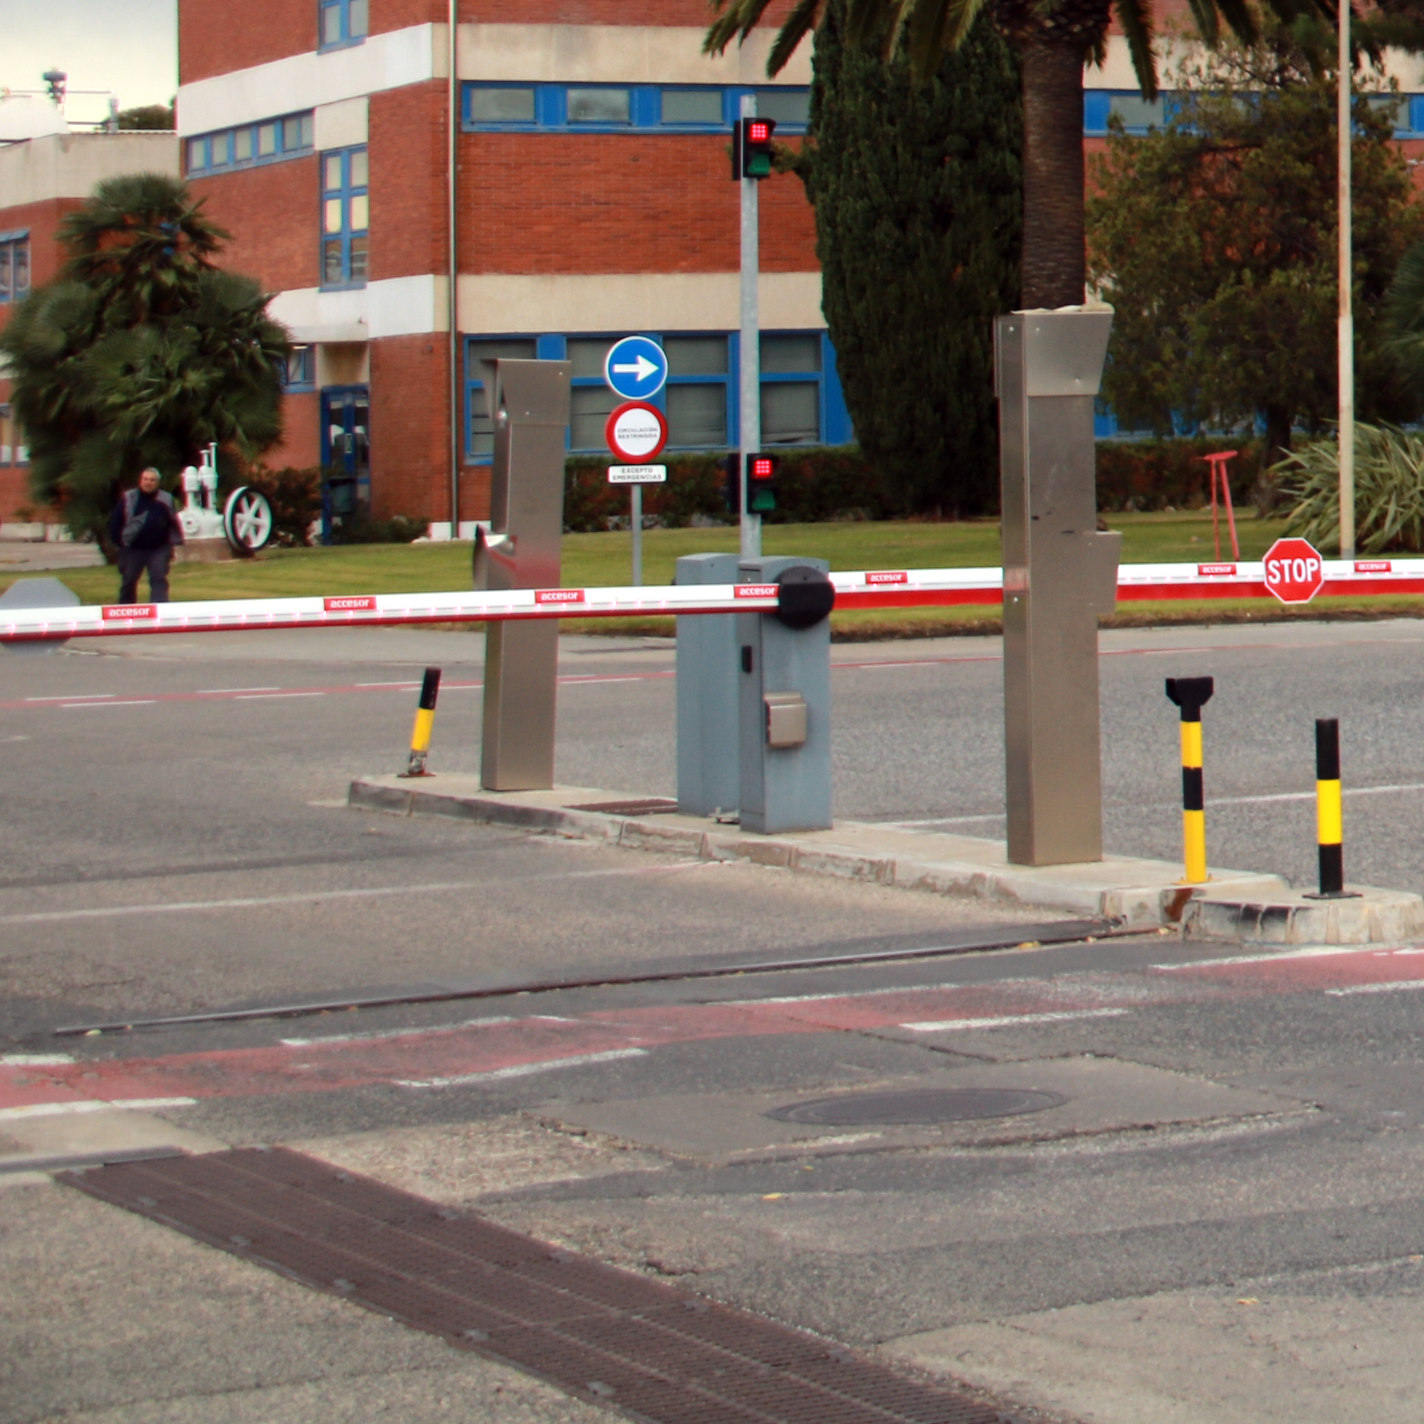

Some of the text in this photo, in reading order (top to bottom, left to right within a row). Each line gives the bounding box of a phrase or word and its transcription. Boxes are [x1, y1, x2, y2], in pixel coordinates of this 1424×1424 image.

[1202, 565, 1233, 574] accesor
[1267, 557, 1320, 584] STOP
[1357, 562, 1388, 571] accesor
[870, 573, 903, 583] accesor
[541, 590, 580, 601] accesor
[738, 586, 777, 598] accesor
[330, 597, 370, 609] accesor
[109, 605, 151, 618] accesor
